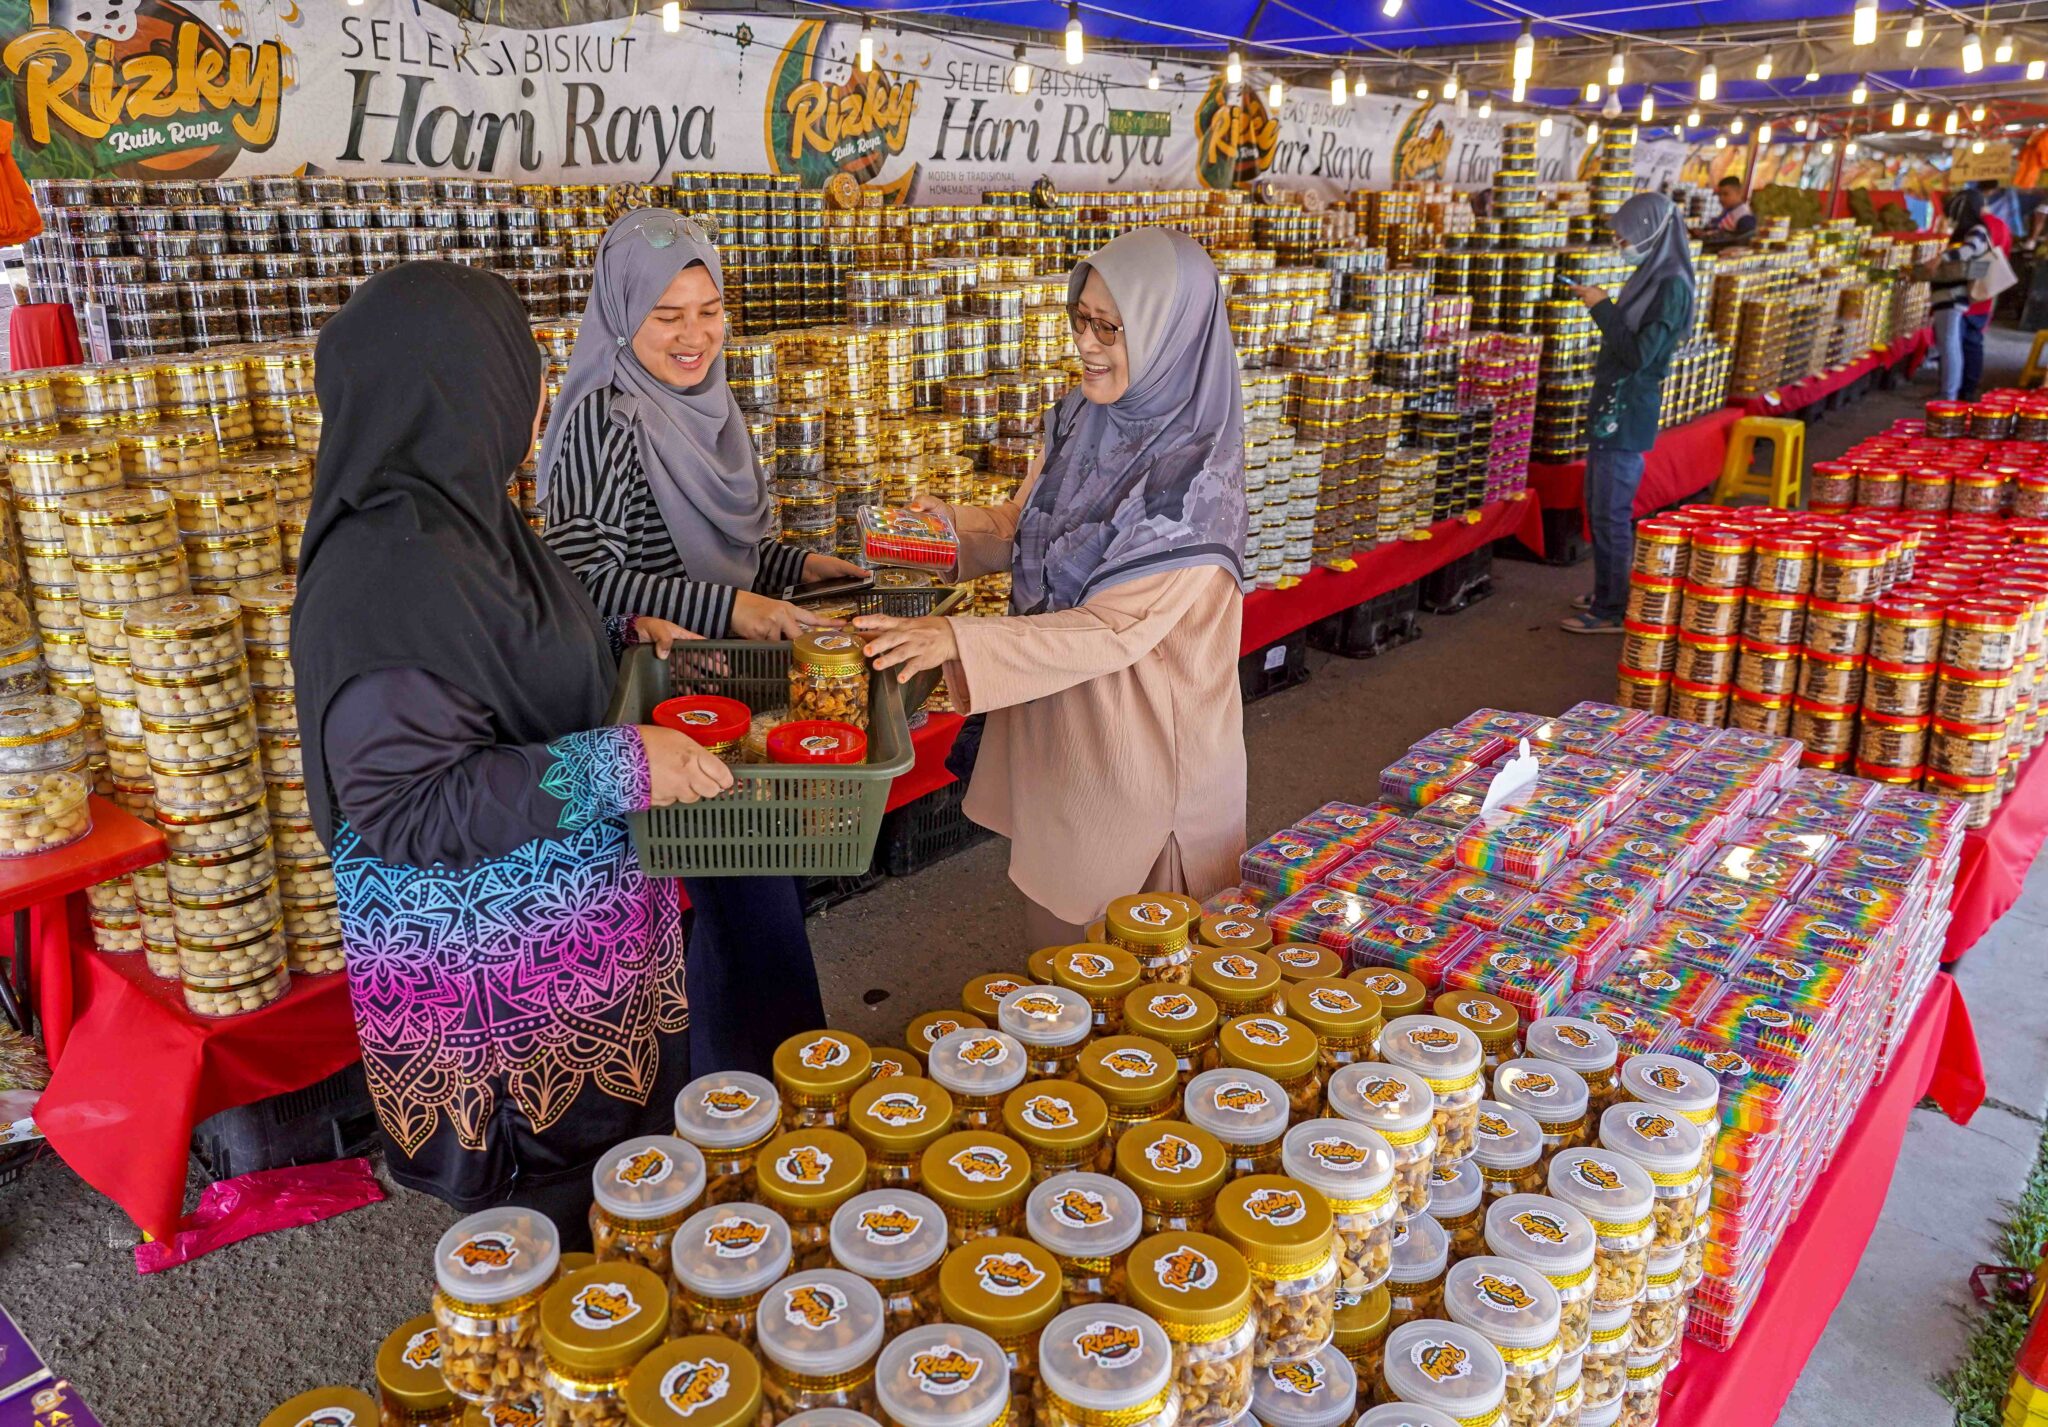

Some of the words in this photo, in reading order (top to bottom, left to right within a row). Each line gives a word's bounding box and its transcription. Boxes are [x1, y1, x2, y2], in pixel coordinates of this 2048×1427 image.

[525, 34, 636, 74] BISKUT
[3, 20, 282, 146] Rizky
[945, 60, 1036, 96] SELEKI
[1039, 70, 1112, 99] BISKUT
[336, 68, 543, 173] Hari
[562, 82, 716, 185] Raya
[787, 69, 916, 158] Rizky
[109, 125, 165, 154] Kuih
[166, 120, 224, 145] Raya
[929, 97, 1044, 163] Hari
[1272, 126, 1313, 176] ari
[1311, 131, 1374, 194] Raya
[928, 171, 957, 182] MODEN
[1411, 1029, 1458, 1046] Rizky
[1512, 1074, 1555, 1091] Rizky
[1311, 1143, 1367, 1162] Rizky
[1247, 1192, 1301, 1217] Rizky
[708, 1223, 768, 1244] Rizky
[861, 1212, 919, 1233] Rizky
[978, 1258, 1042, 1288] Rizky
[1476, 1275, 1536, 1309] Rizky
[1077, 1327, 1140, 1356] Rizky
[912, 1354, 980, 1380] Rizky
